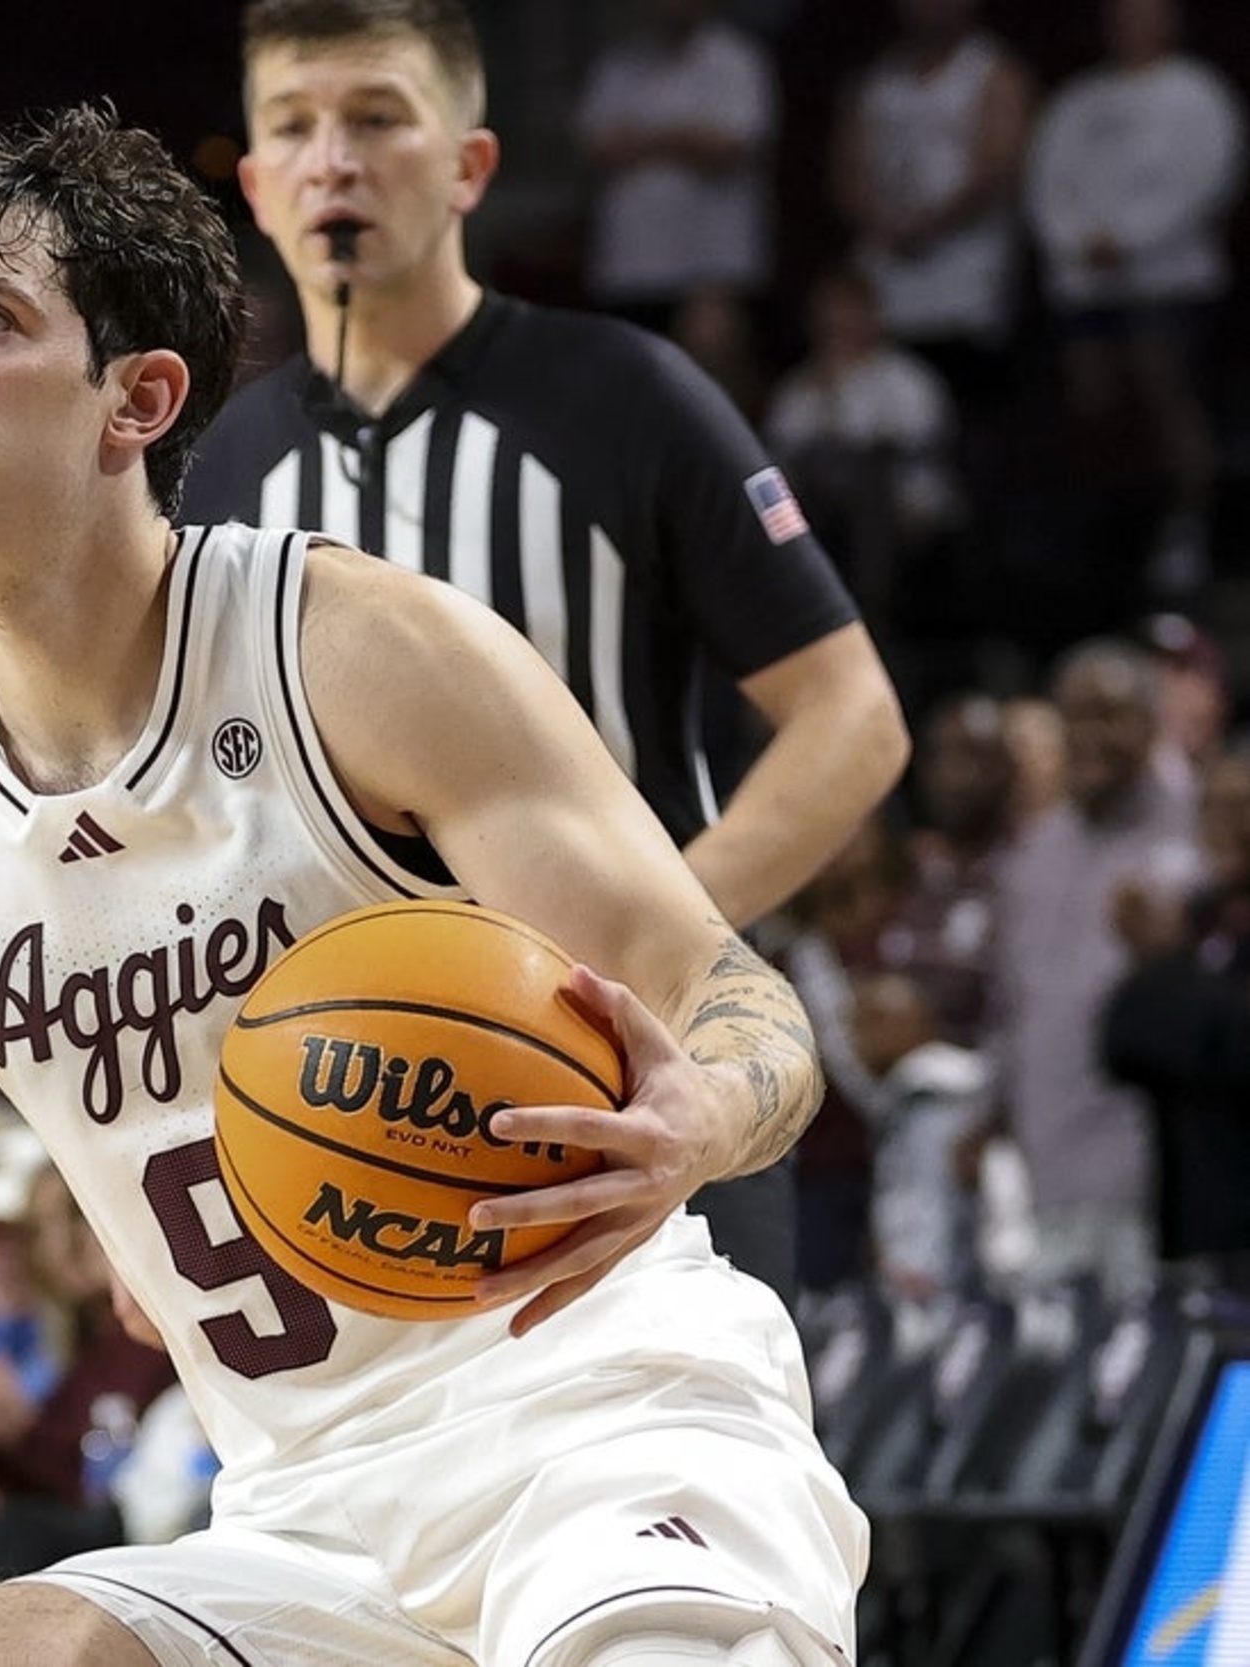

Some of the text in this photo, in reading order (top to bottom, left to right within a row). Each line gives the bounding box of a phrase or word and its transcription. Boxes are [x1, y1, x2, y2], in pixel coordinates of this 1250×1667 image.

[218, 725, 256, 773] SEC
[386, 1128, 473, 1158] EVO NXT
[142, 1136, 338, 1380] 9
[303, 1181, 506, 1271] NCAA
